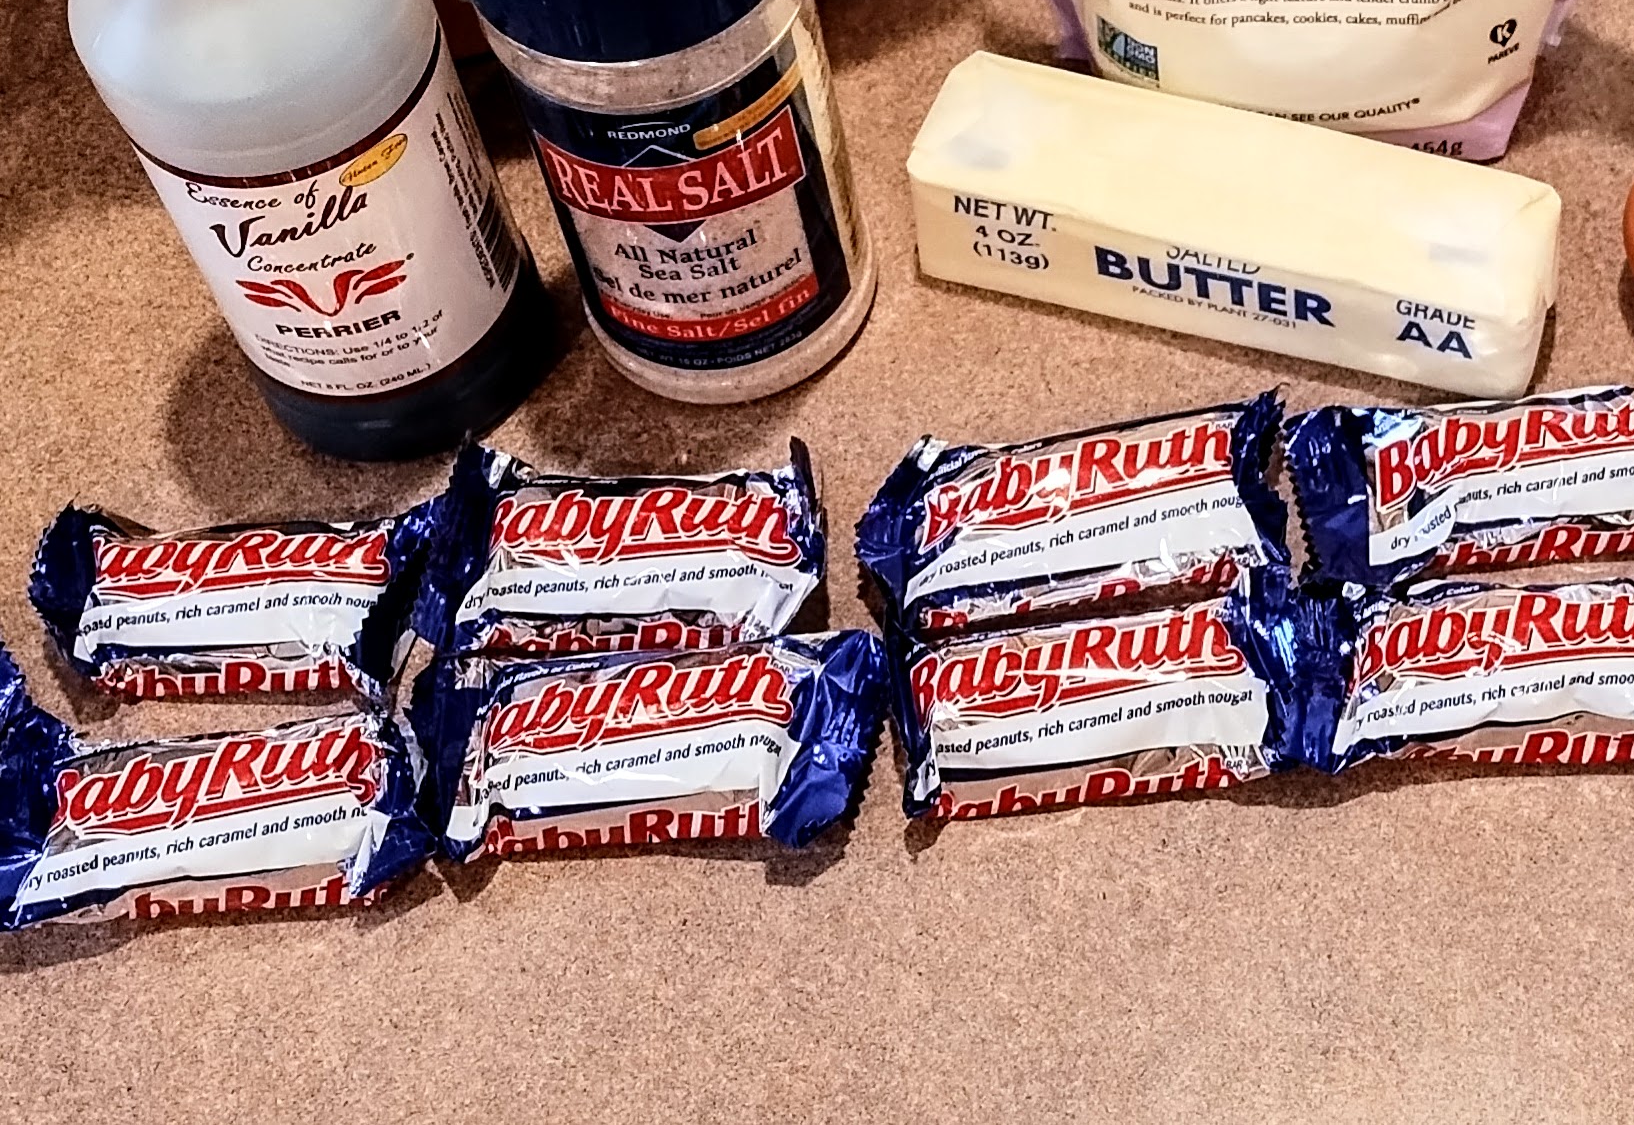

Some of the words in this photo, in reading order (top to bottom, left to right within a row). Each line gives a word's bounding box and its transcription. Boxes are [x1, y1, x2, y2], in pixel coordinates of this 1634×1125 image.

[607, 123, 691, 141] REDMOND
[547, 149, 673, 215] REAL
[677, 127, 788, 211] SALT
[185, 181, 282, 210] Essence
[294, 180, 319, 209] of
[209, 185, 369, 258] Vanilla
[953, 195, 1006, 221] NET
[1013, 204, 1057, 232] WT.
[614, 242, 649, 264] All
[658, 228, 758, 266] Natural
[975, 226, 989, 238] 4
[997, 229, 1040, 247] OZ.
[247, 242, 377, 274] Concentrate
[638, 263, 682, 282] Sea
[690, 256, 741, 279] Salt
[973, 241, 1049, 270] (113g)
[1094, 245, 1336, 328] BUTTER
[1132, 285, 1184, 304] PACKED
[1187, 296, 1203, 308] BY
[1207, 302, 1250, 318] PLANT
[275, 310, 402, 339] PERRIER
[1396, 299, 1477, 330] GRADE
[1396, 321, 1473, 360] AA
[909, 608, 1247, 726] BabyRuth
[974, 728, 1034, 755] peanuts,
[1037, 721, 1064, 738] rich
[1068, 707, 1123, 732] caramel
[1126, 701, 1152, 719] and
[1155, 691, 1205, 714] smooth
[1207, 689, 1253, 706] nougat
